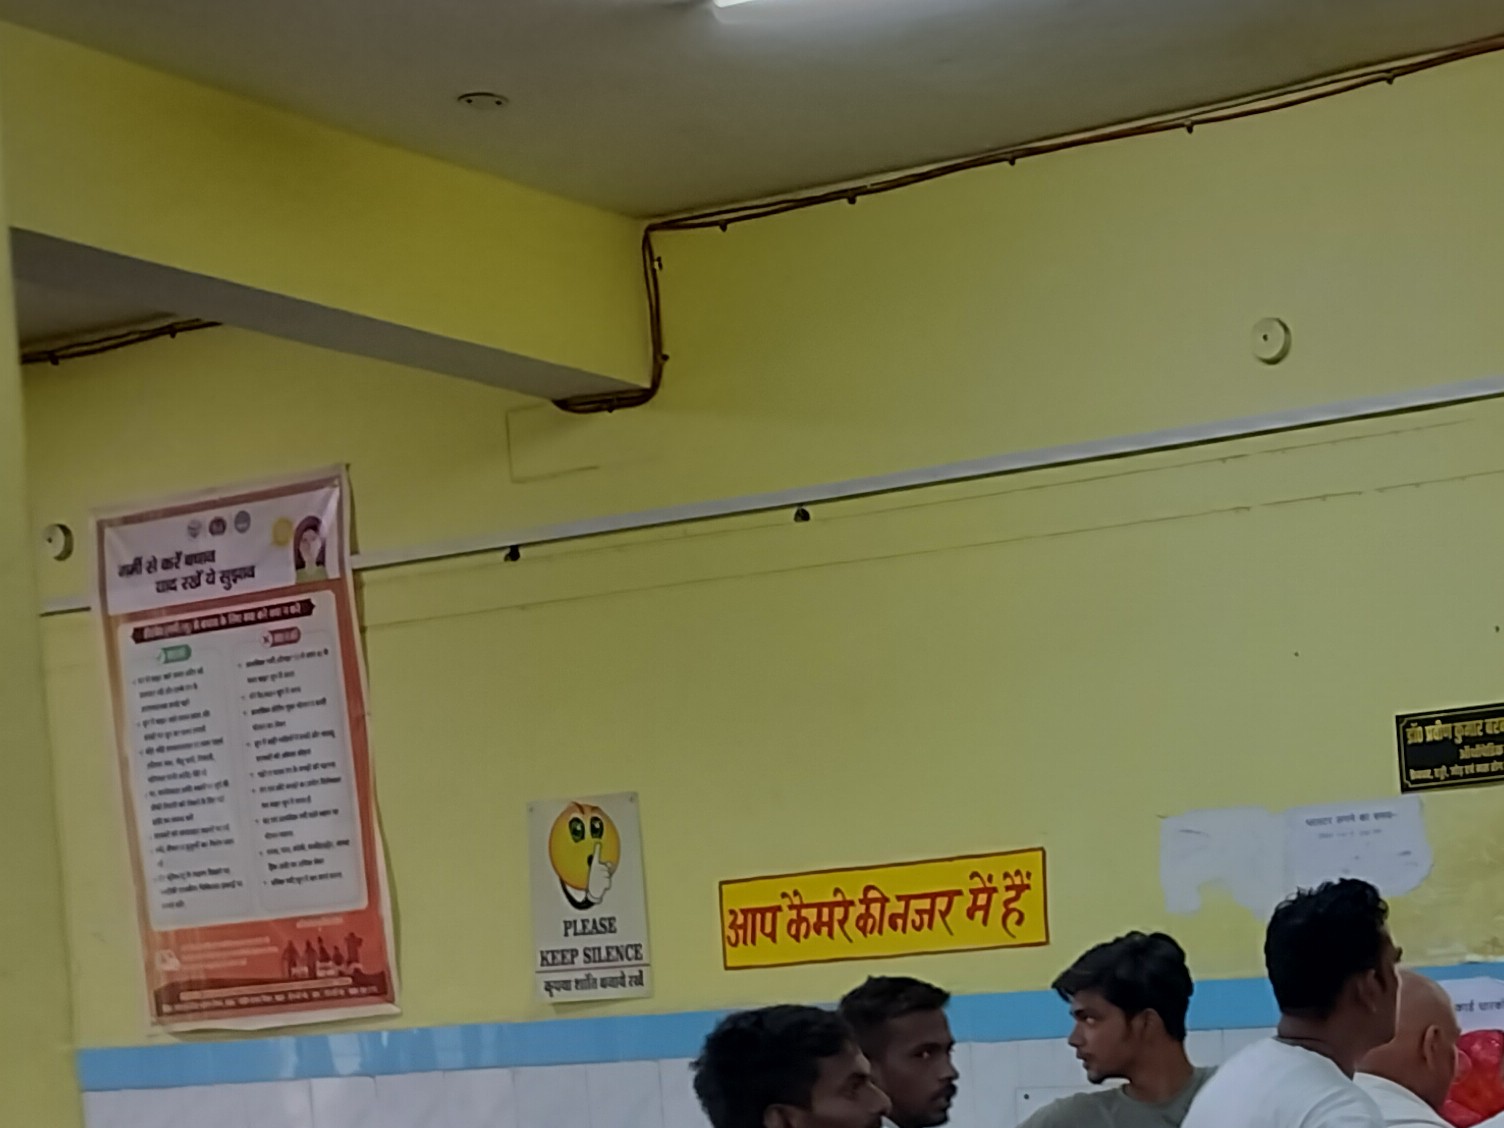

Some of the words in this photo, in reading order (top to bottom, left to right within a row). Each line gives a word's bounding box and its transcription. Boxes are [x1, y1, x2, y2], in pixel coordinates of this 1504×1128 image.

[726, 904, 783, 948] आप
[966, 870, 998, 927] में
[563, 916, 617, 937] PLEASE
[540, 948, 579, 968] KEEP
[583, 942, 644, 965] SILENCE
